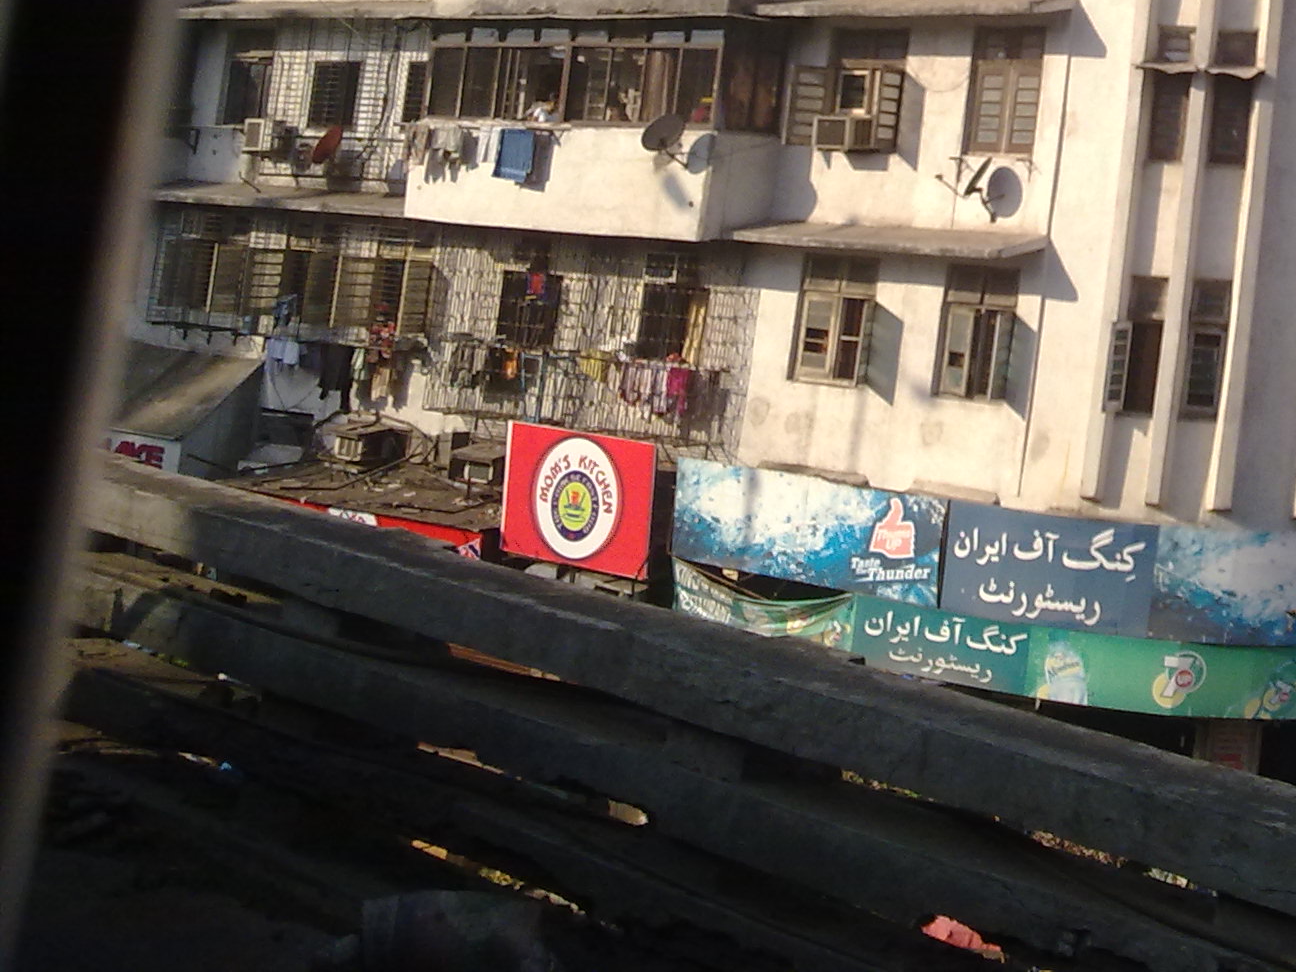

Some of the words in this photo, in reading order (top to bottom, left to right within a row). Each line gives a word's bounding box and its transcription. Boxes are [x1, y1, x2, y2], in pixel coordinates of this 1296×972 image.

[540, 454, 571, 503] MOM'S
[578, 455, 613, 514] KITCHEN
[954, 527, 1007, 565] ایران
[1013, 530, 1060, 562] آف
[867, 564, 931, 582] Thunder
[864, 611, 920, 644] ایران
[924, 617, 965, 645] آف
[966, 625, 1027, 655] کنگ
